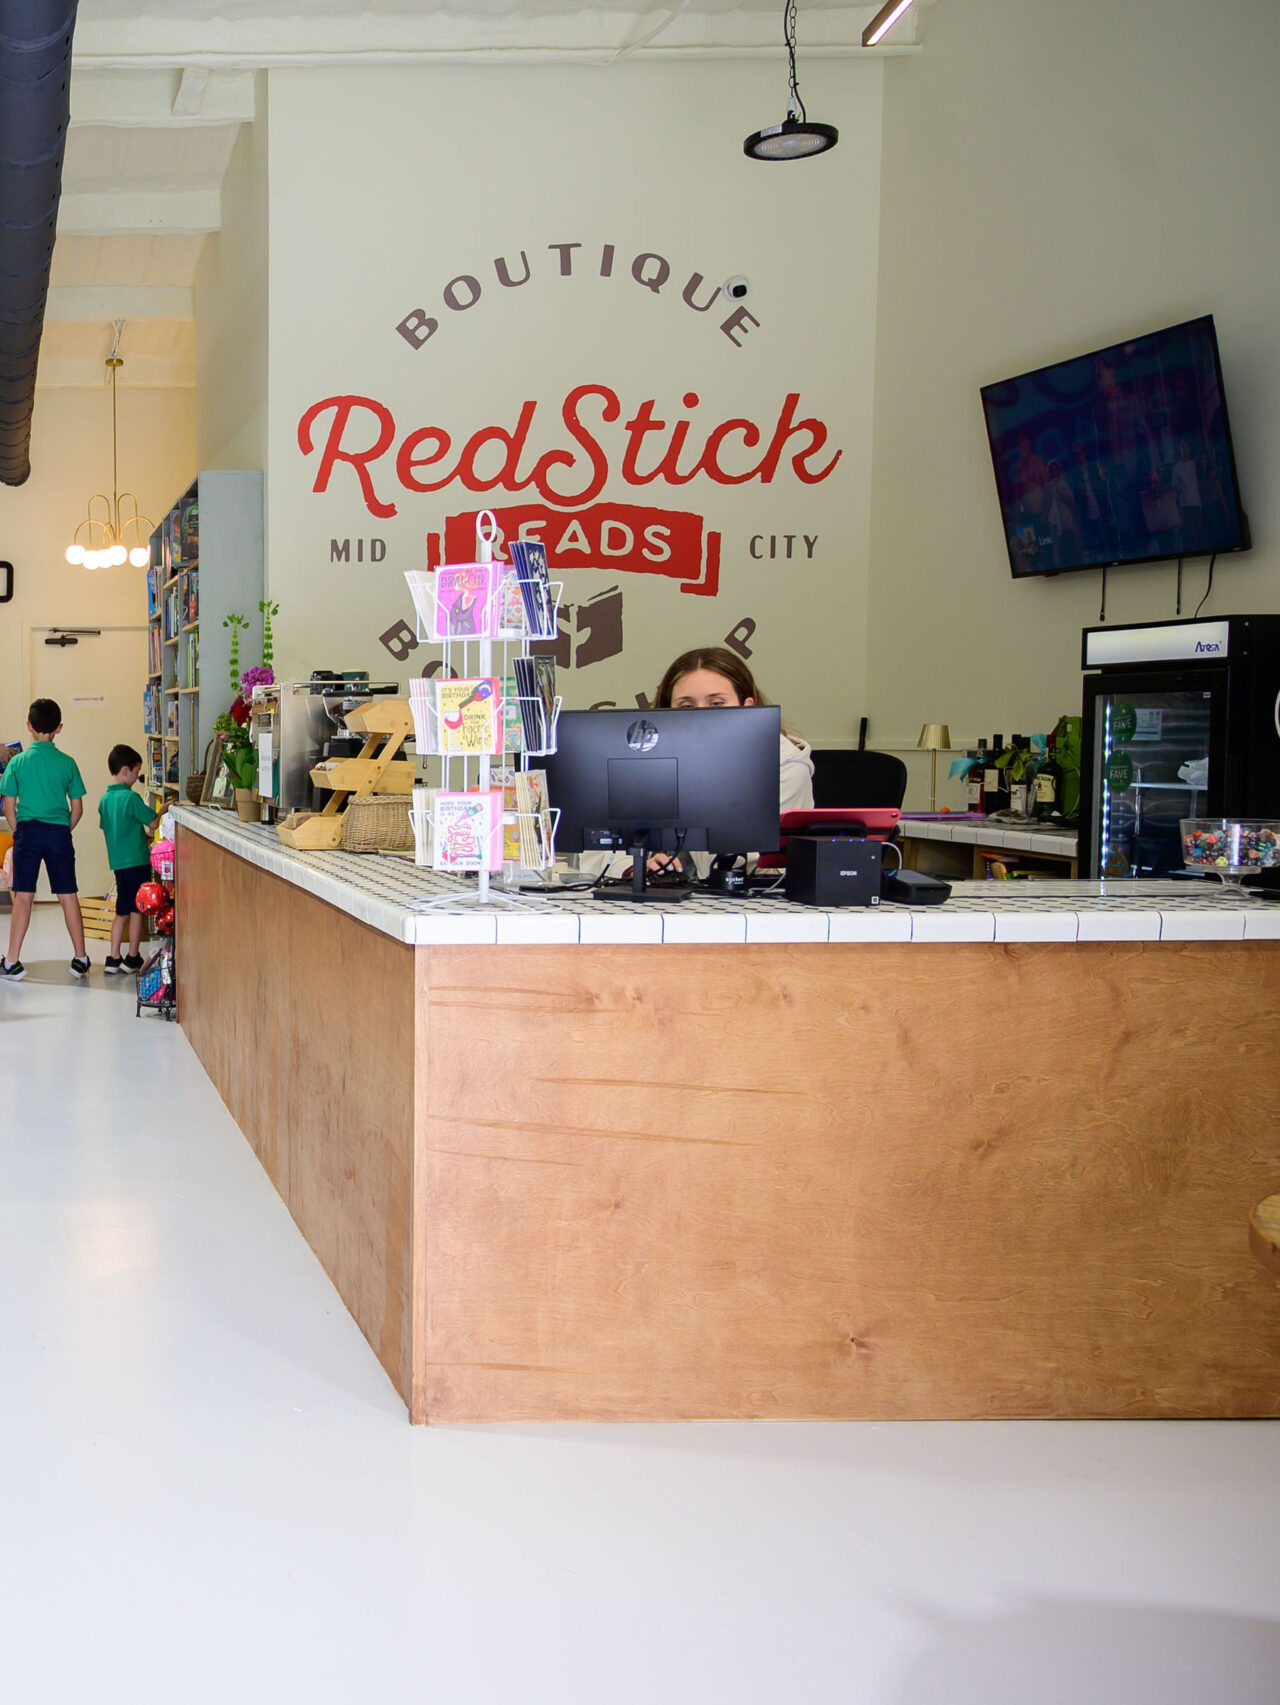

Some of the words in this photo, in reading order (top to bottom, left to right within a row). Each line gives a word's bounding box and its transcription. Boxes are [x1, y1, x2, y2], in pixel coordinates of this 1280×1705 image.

[396, 243, 760, 350] BOUTIQUE
[330, 538, 387, 563] MID
[480, 520, 673, 562] READS
[749, 535, 818, 560] CITY
[1113, 719, 1132, 730] FAVE
[1110, 769, 1128, 779] FAVE
